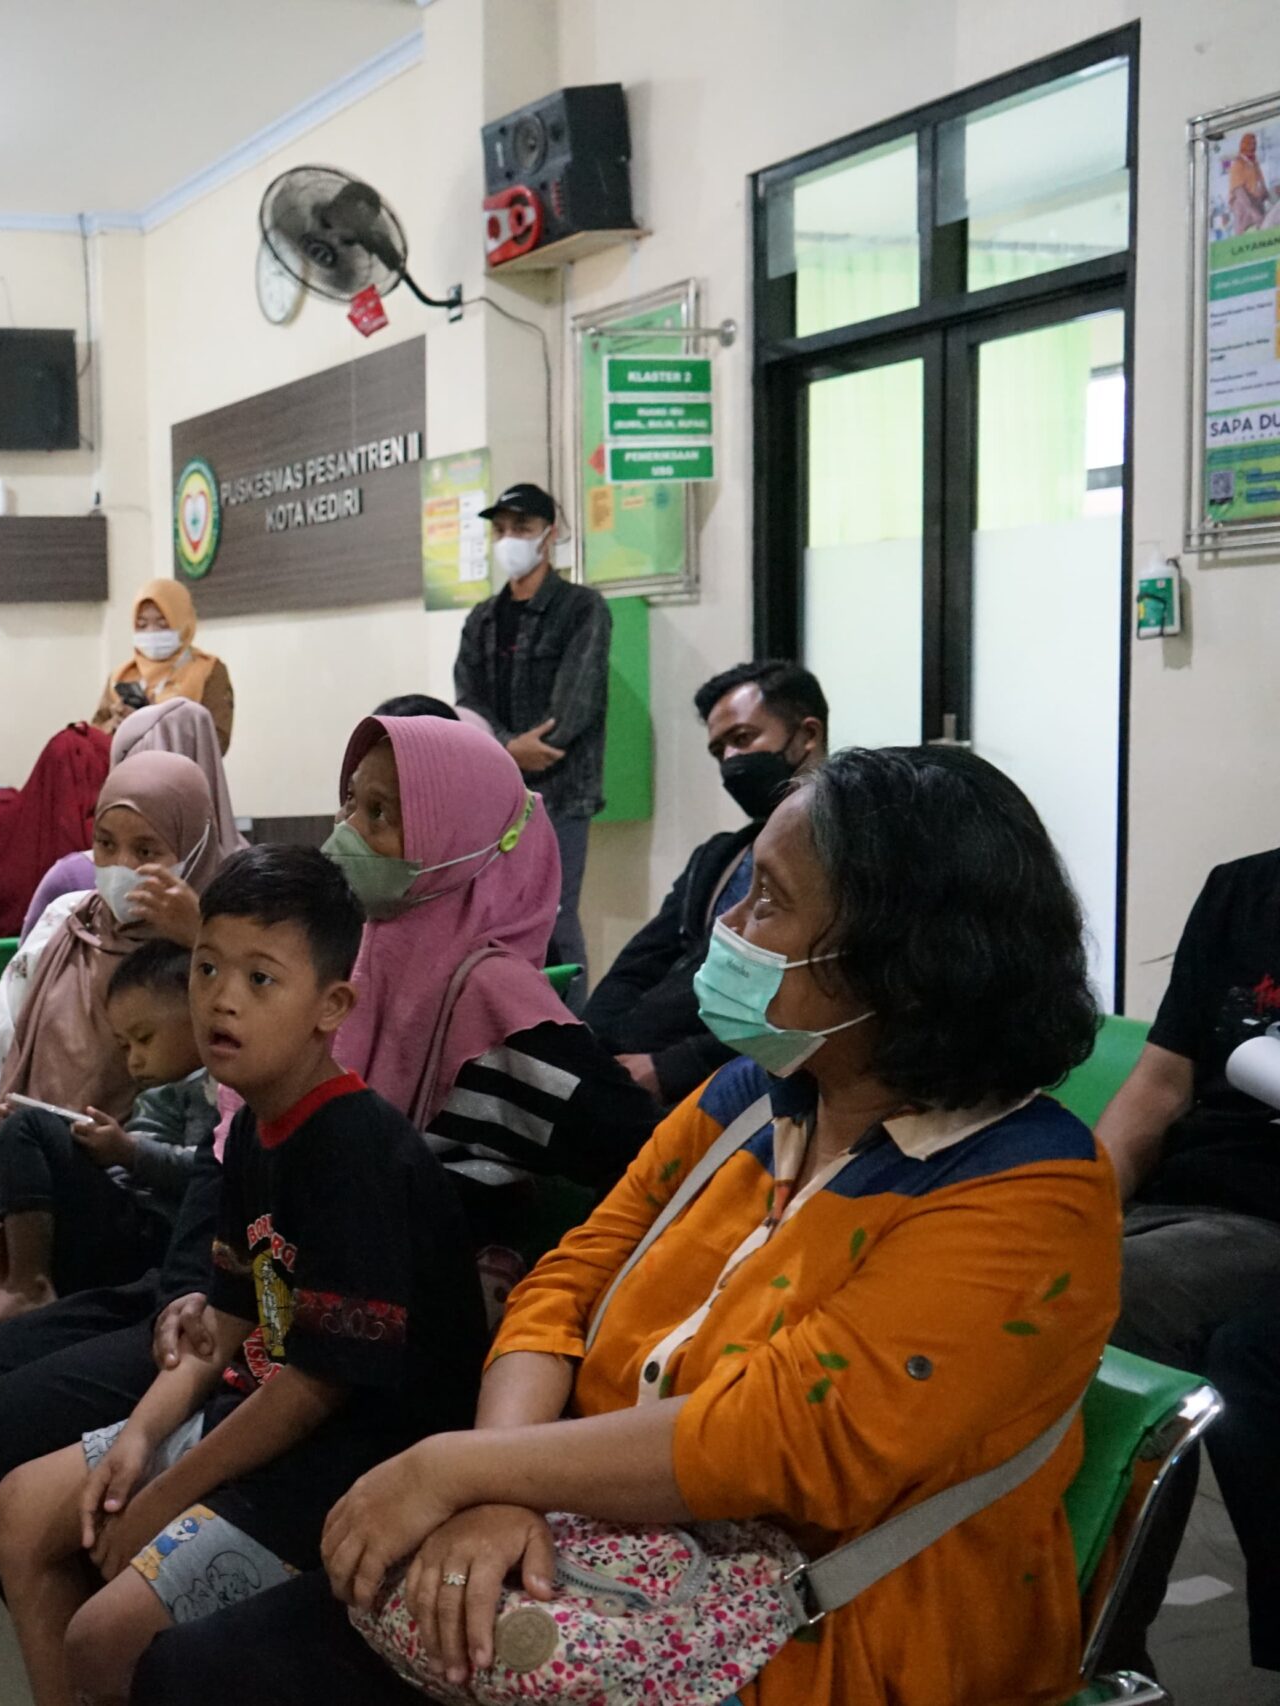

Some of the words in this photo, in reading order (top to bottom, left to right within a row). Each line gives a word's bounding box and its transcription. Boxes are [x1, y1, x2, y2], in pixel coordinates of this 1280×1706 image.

[627, 371, 682, 383] KLASTER
[683, 371, 692, 383] 2
[1210, 417, 1253, 437] SAPA
[220, 463, 304, 506] PUSKESMAS
[305, 435, 405, 487] PESANTREN
[265, 502, 306, 532] KOTA
[306, 488, 361, 525] KEDIRI
